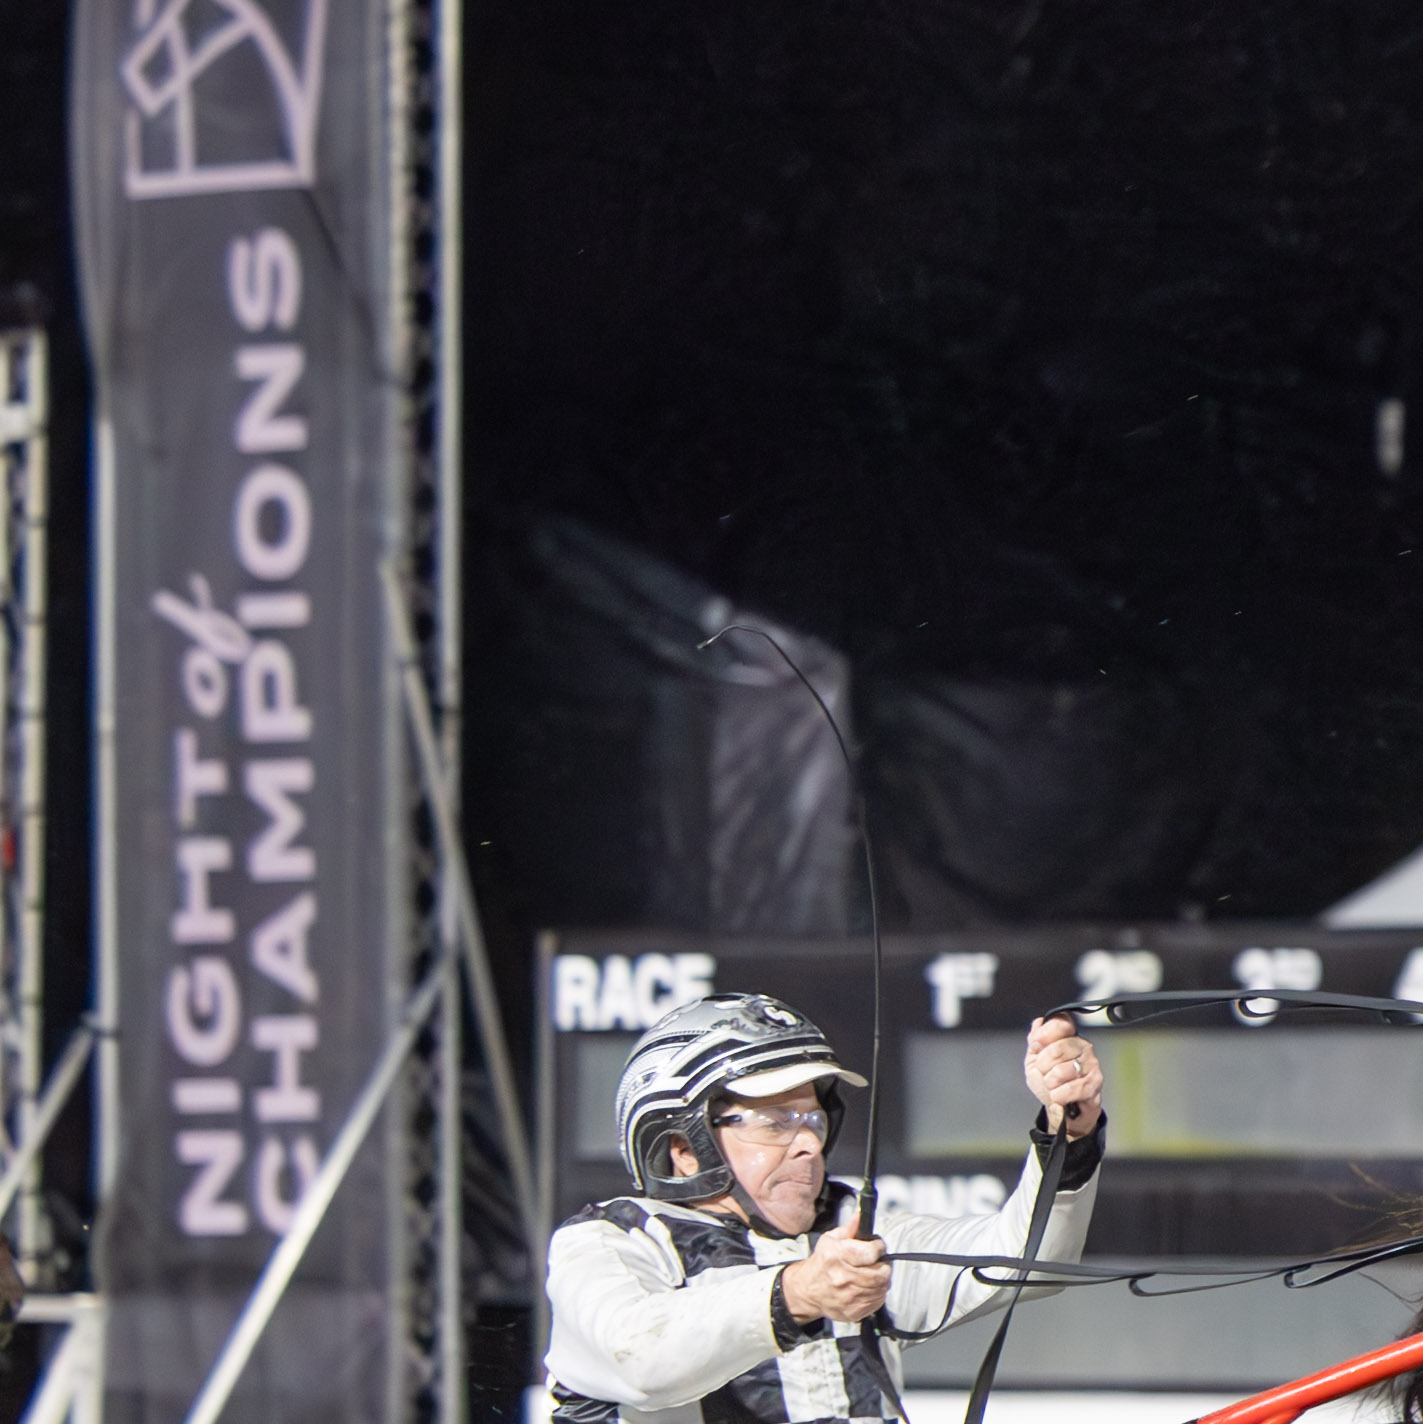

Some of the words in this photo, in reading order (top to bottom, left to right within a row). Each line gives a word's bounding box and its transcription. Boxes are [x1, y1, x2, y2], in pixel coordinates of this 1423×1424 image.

[153, 572, 253, 720] of
[228, 229, 319, 1237] CHAMPIONS
[167, 729, 249, 1236] NIGHT
[554, 952, 716, 1031] RACE
